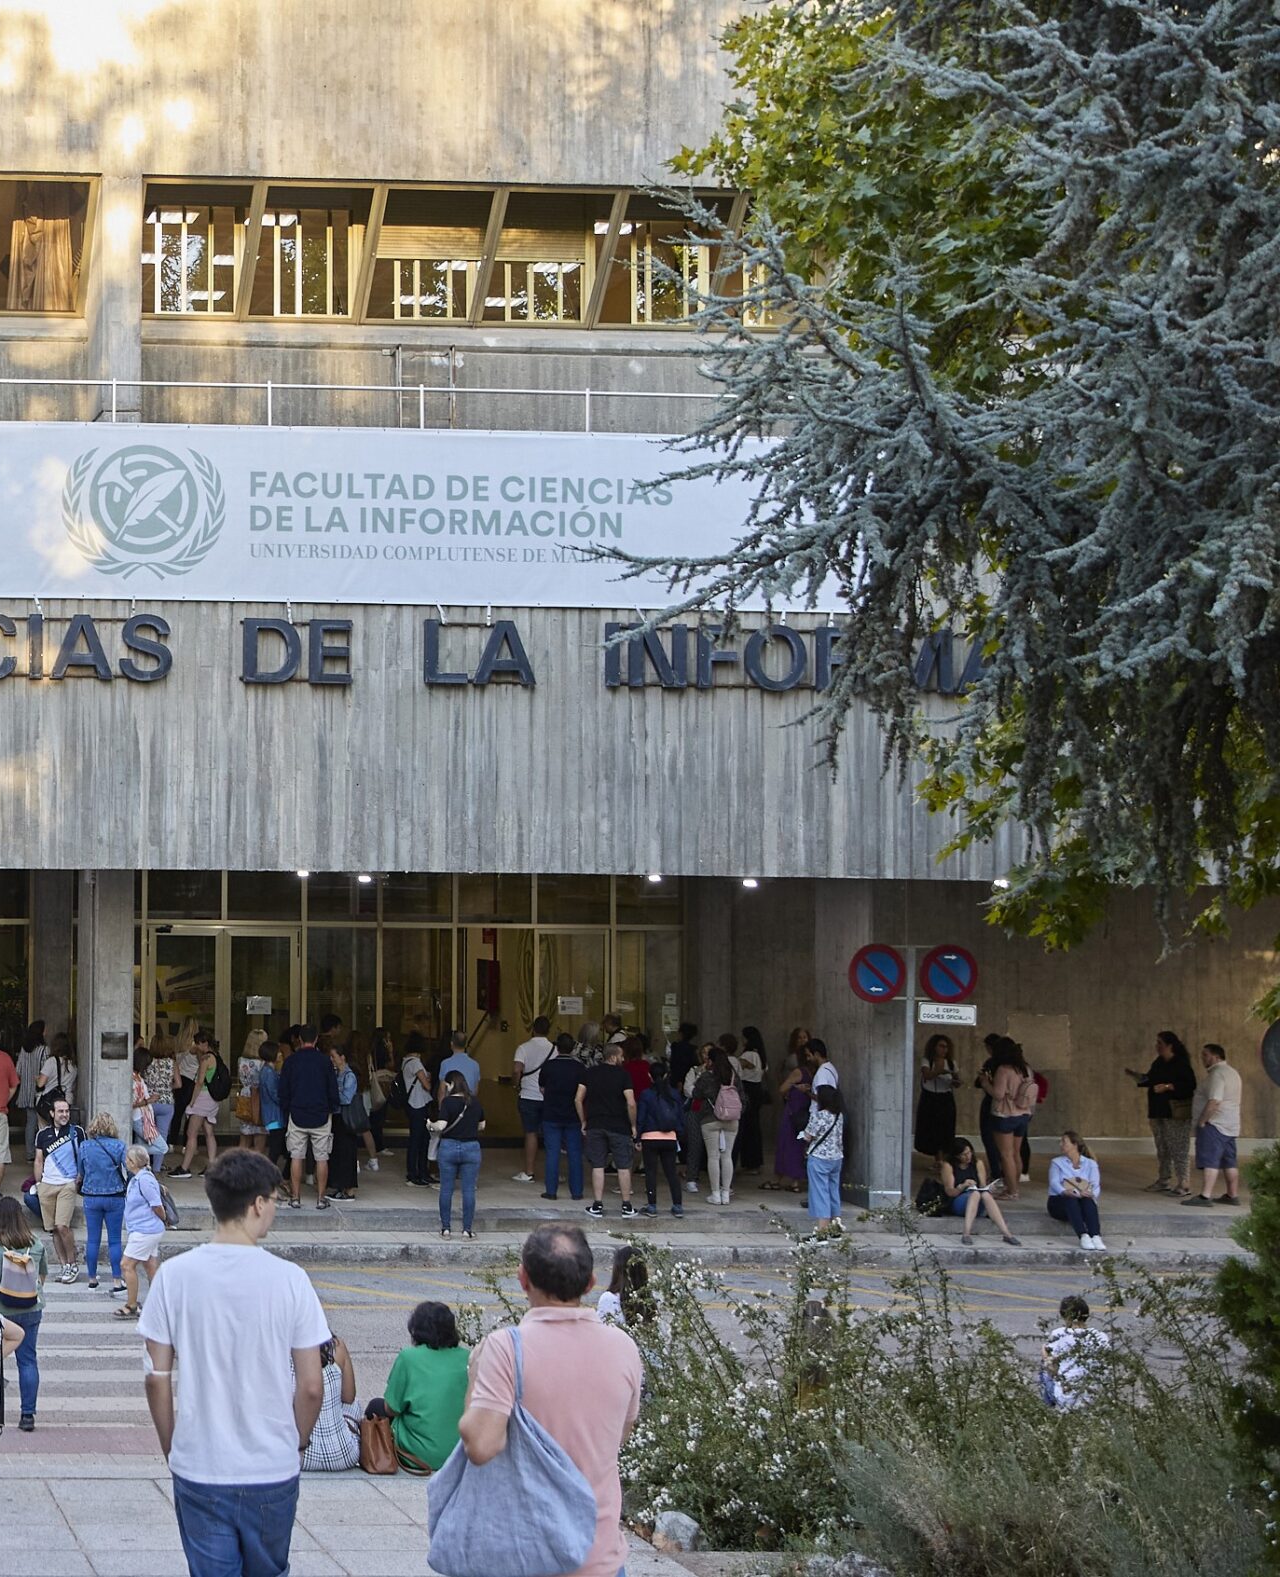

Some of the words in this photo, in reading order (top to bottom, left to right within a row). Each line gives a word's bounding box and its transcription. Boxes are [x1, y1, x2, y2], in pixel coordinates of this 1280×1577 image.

[249, 471, 436, 501] FACULTAD
[446, 474, 490, 502] DE
[500, 476, 673, 506] CIENCIAS
[249, 505, 294, 532] DE
[304, 506, 350, 533] LA
[359, 505, 622, 539] INFORMACIÓN
[249, 543, 378, 560] UNIVERSIDAD
[382, 545, 518, 563] COMPLUTENSE
[522, 547, 547, 563] DE
[242, 618, 354, 685] DE
[424, 618, 537, 686] LA
